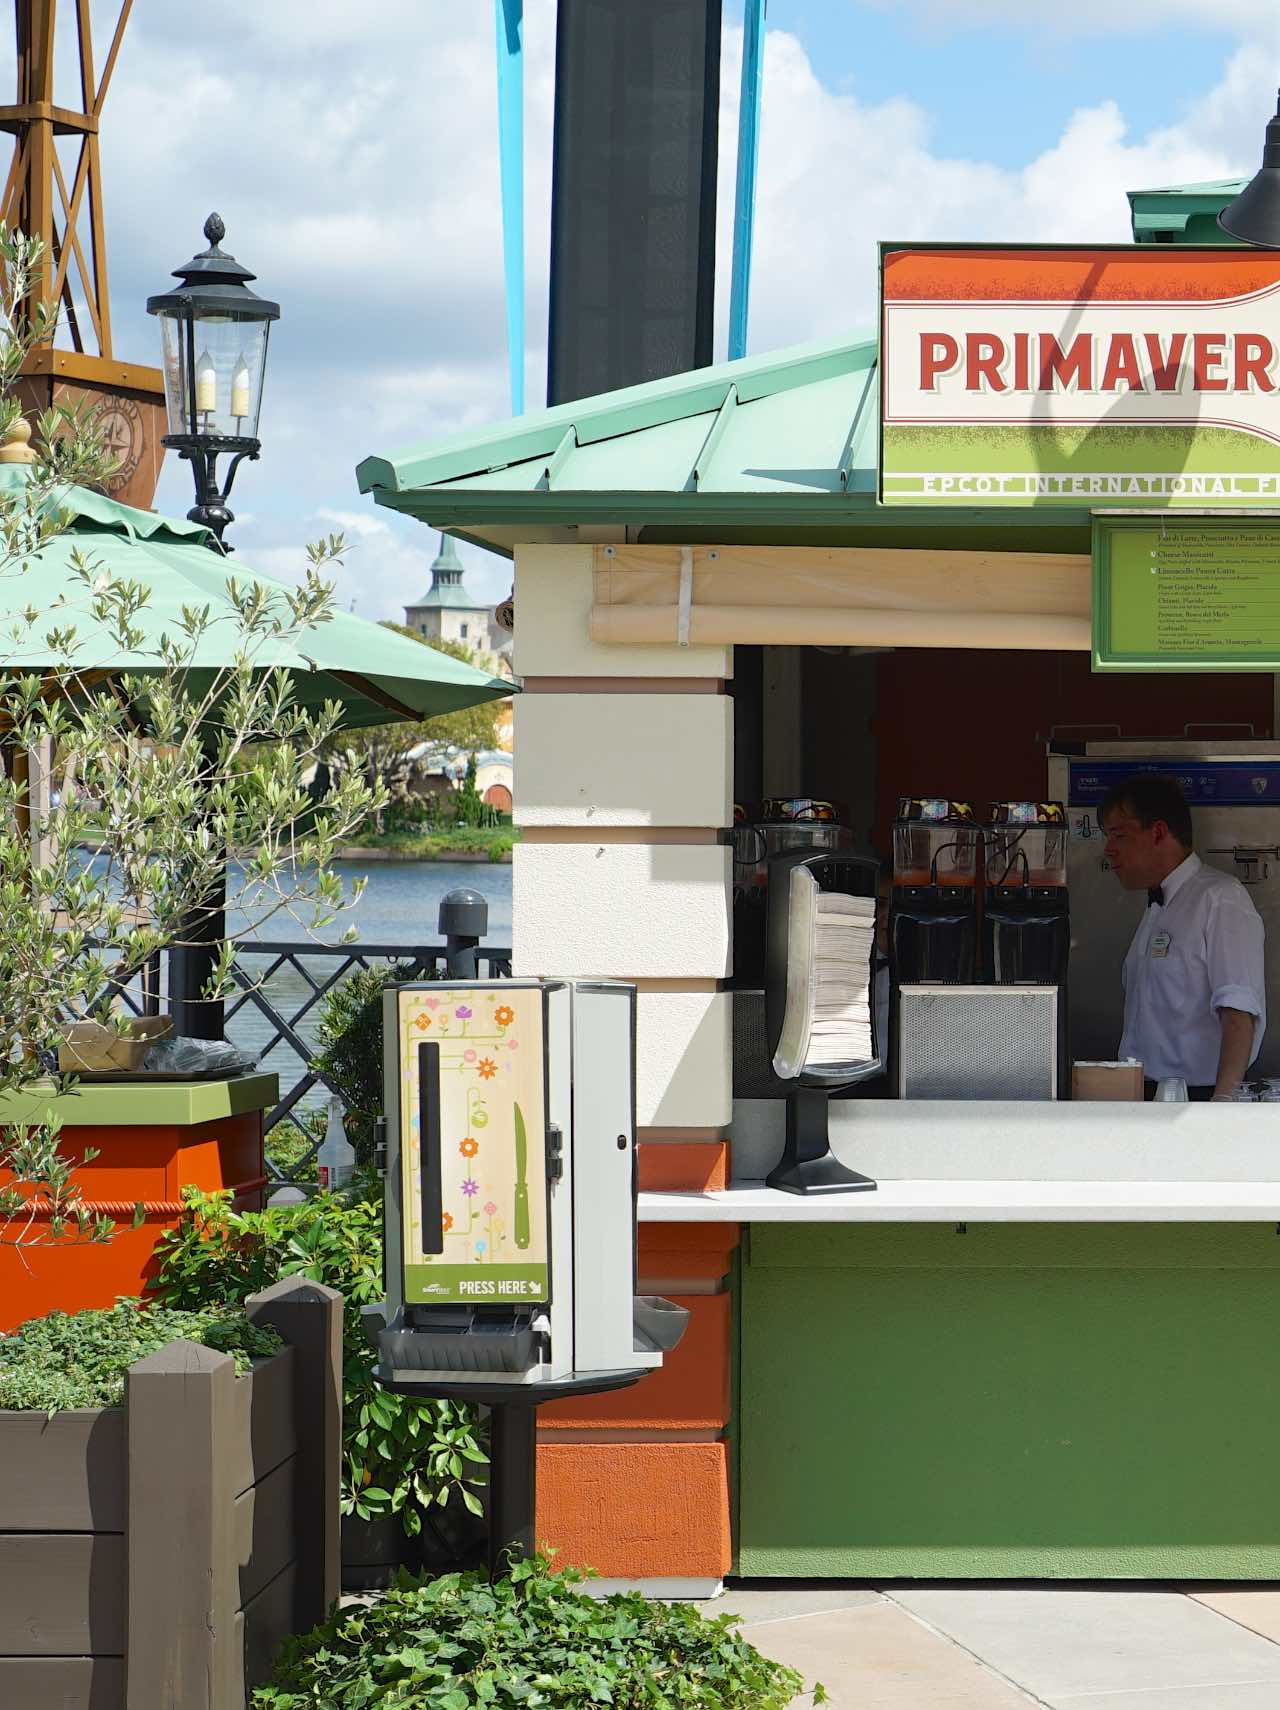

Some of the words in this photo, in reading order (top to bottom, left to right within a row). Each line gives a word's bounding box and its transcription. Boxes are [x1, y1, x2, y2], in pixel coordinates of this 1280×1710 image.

[922, 476, 1012, 494] EPCOT
[1024, 476, 1242, 494] INTERNATIONAL
[459, 1280, 496, 1295] PRESS
[498, 1280, 528, 1294] HERE
